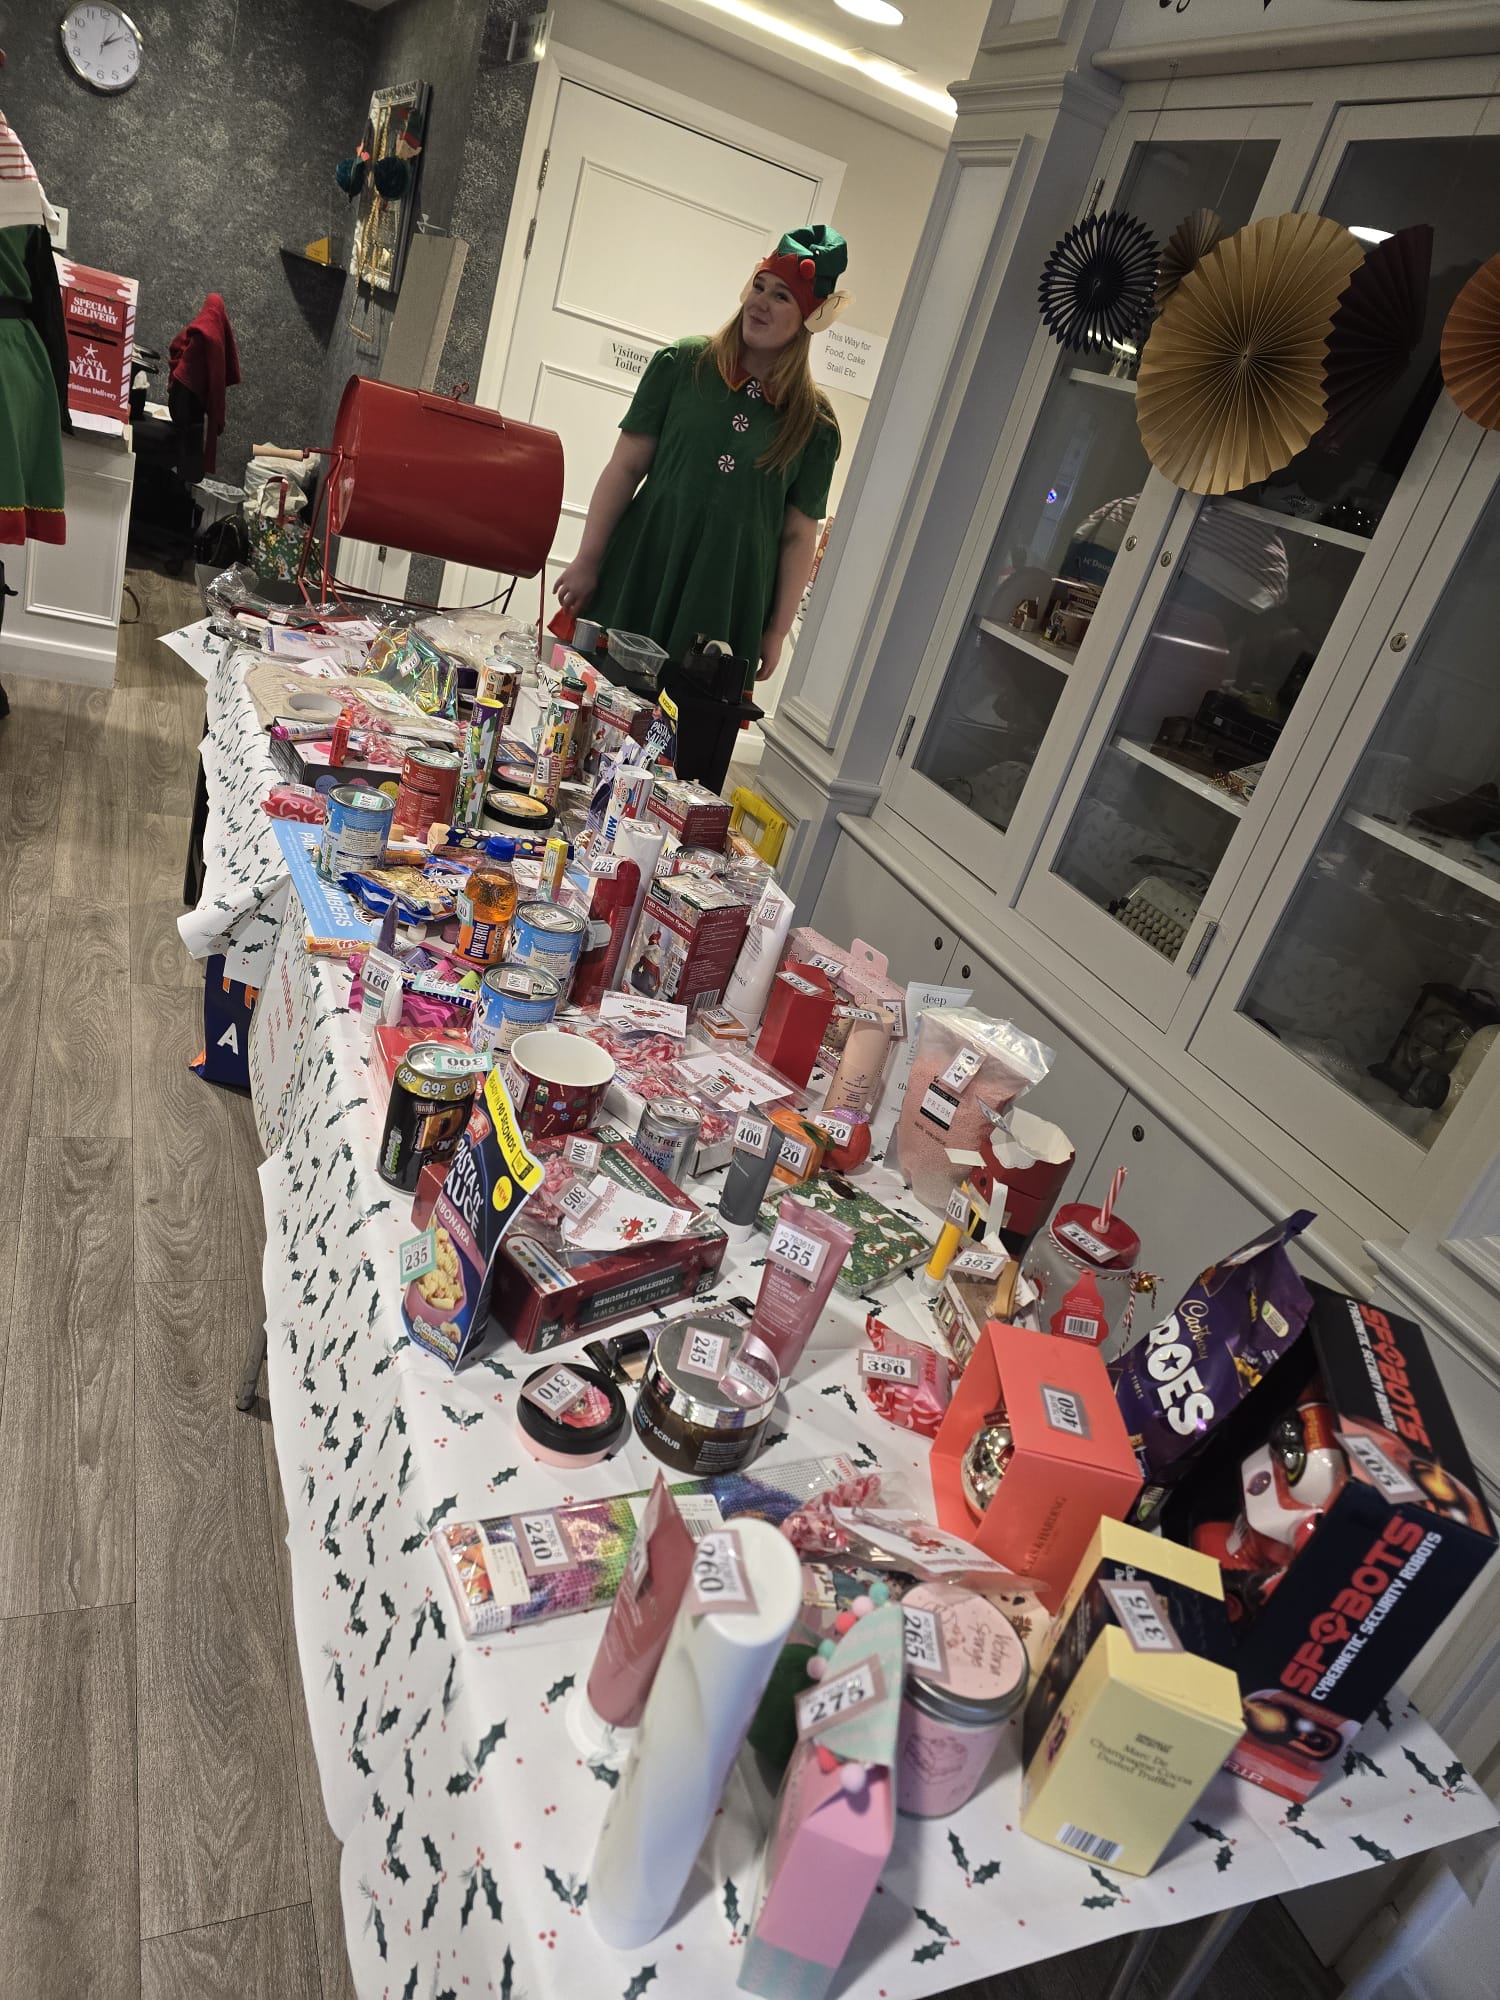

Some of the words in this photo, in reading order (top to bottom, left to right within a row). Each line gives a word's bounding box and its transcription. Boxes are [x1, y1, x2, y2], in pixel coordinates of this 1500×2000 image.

[96, 70, 105, 80] 6
[111, 70, 120, 81] 5
[70, 304, 119, 325] DELIVERY
[73, 296, 115, 315] SPECIAL
[828, 329, 843, 342] This
[844, 335, 861, 349] Way
[861, 340, 872, 352] for
[76, 355, 104, 368] SANTA
[612, 342, 649, 364] Visitors
[824, 345, 847, 361] Food,
[846, 352, 867, 366] Cake
[69, 360, 112, 384] MAIL
[614, 356, 642, 374] Toilet
[826, 361, 844, 375] Stall
[844, 366, 858, 378] Etc
[68, 383, 92, 393] ristmas
[92, 387, 117, 400] Delivery
[594, 860, 614, 873] 225
[811, 957, 836, 974] 345
[365, 970, 390, 992] 160
[922, 992, 948, 1008] deep
[217, 1022, 239, 1056] A
[447, 1057, 484, 1066] 300
[952, 1055, 976, 1083] 470
[422, 1080, 448, 1096] 69P
[640, 1125, 683, 1149] VER-TREE
[738, 1126, 761, 1147] 400
[571, 1141, 588, 1163] 300
[781, 1146, 800, 1165] 20
[444, 1167, 477, 1239] AUCE
[563, 1186, 587, 1210] 305
[437, 1199, 470, 1248] RBONARA
[404, 1247, 429, 1272] 235
[775, 1238, 813, 1268] 255
[958, 1256, 995, 1272] 395
[688, 1335, 711, 1368] 245
[867, 1361, 906, 1376] 390
[1145, 1314, 1215, 1437] ROES
[537, 1374, 571, 1401] 310
[652, 1425, 681, 1451] SCRUB
[523, 1520, 554, 1561] 240
[695, 1543, 725, 1593] 260
[1128, 1595, 1167, 1643] 315
[1311, 1633, 1368, 1701] CYBERNETIC
[1359, 1579, 1408, 1636] SECURITY
[1398, 1531, 1443, 1582] ROBOTS
[902, 1613, 927, 1661] 265
[809, 1686, 865, 1723] 275
